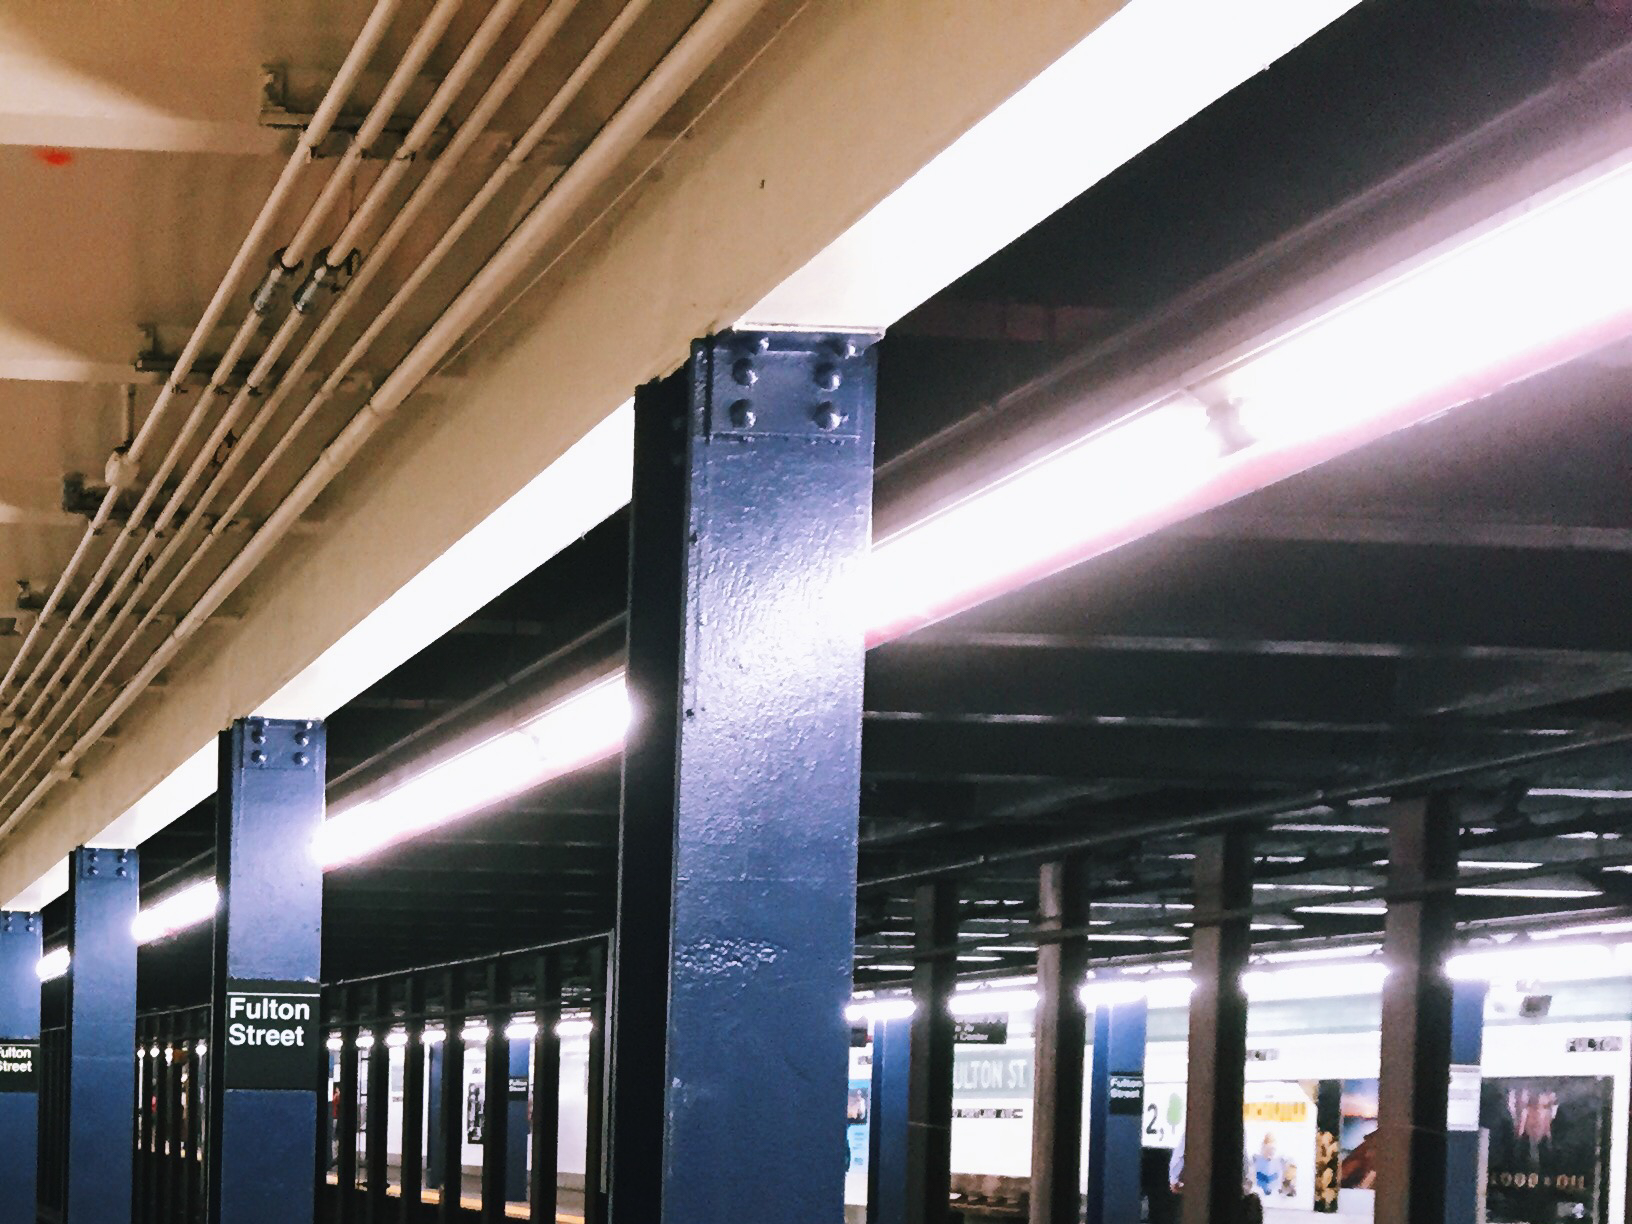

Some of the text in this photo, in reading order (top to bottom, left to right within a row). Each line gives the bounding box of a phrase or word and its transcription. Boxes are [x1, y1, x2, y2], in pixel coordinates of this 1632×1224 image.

[230, 997, 310, 1020] Fulton
[229, 1023, 304, 1046] Street
[954, 1060, 1004, 1089] ULTON
